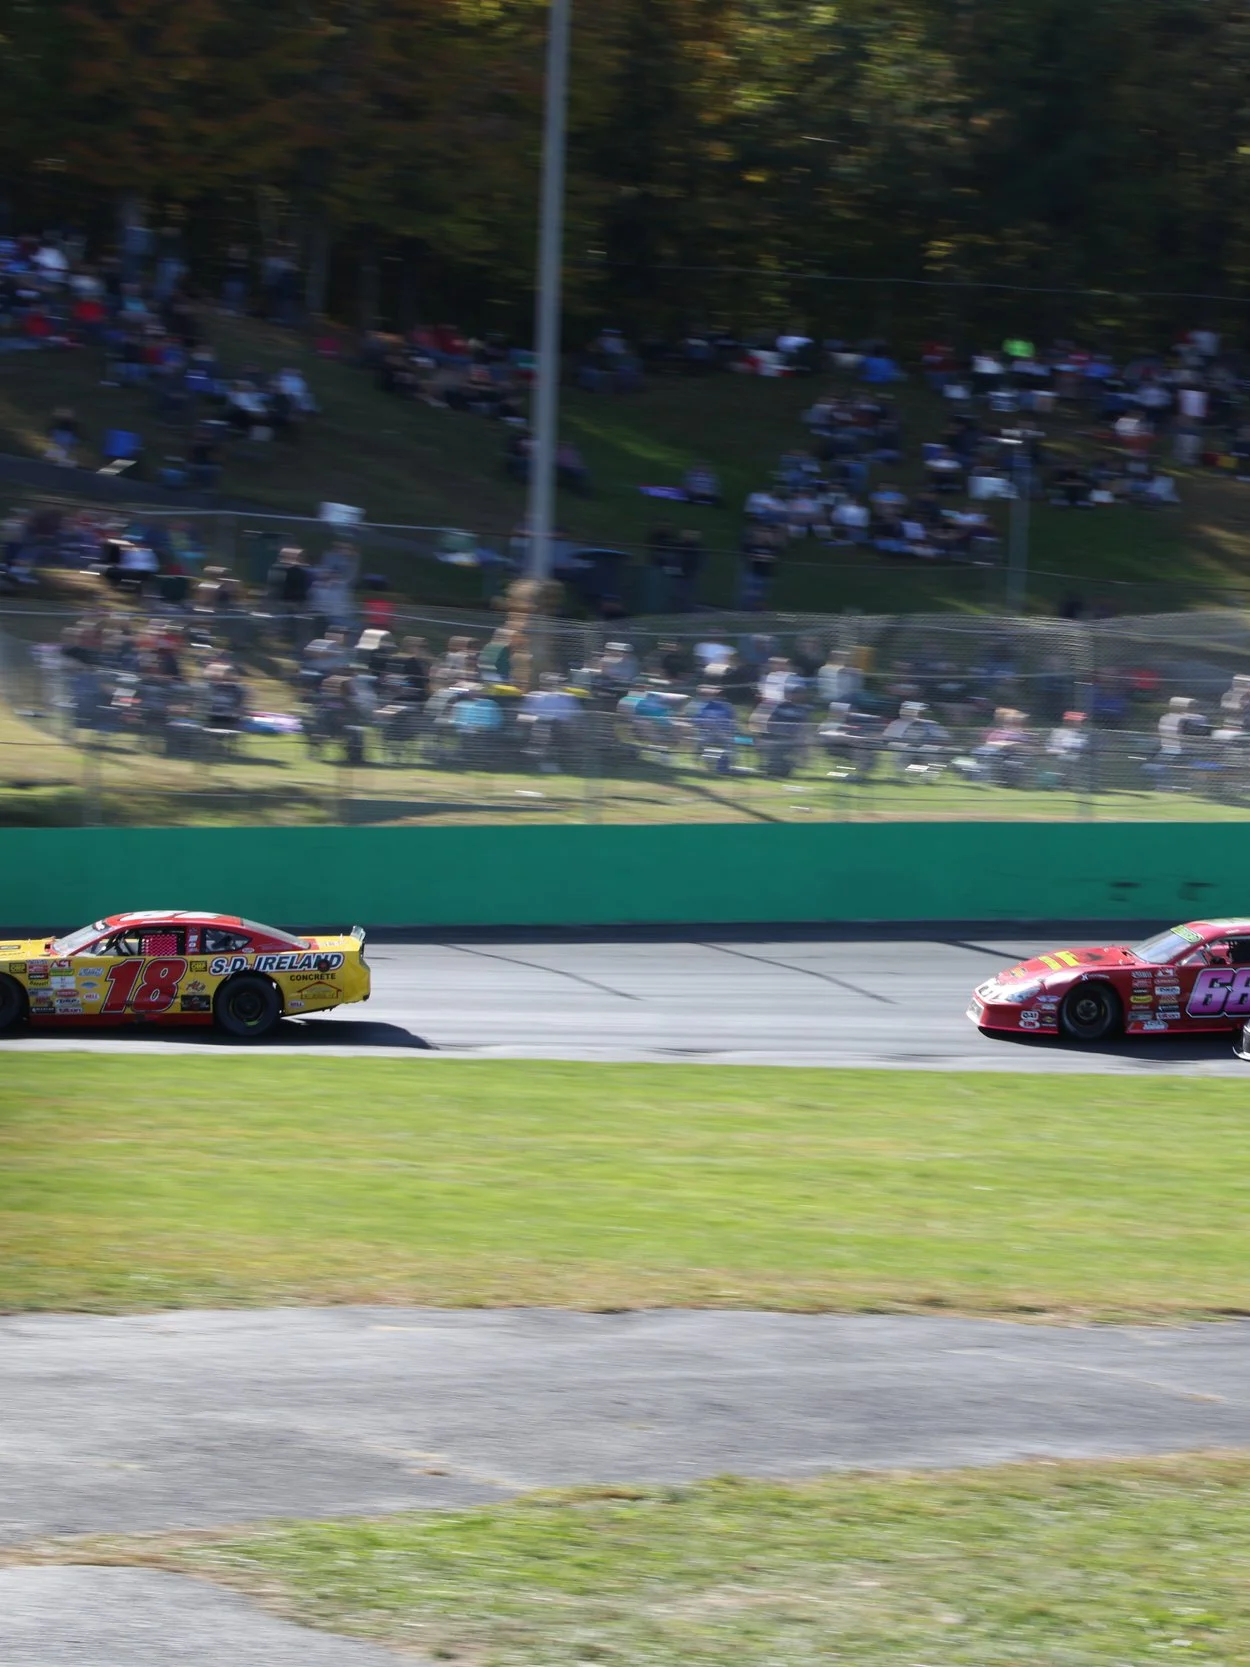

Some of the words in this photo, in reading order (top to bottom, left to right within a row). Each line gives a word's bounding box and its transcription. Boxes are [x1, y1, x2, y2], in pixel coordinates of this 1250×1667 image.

[211, 957, 249, 975] S.D.
[252, 953, 343, 973] IRELAND
[100, 957, 188, 1014] 18
[290, 973, 336, 981] CONCRETE
